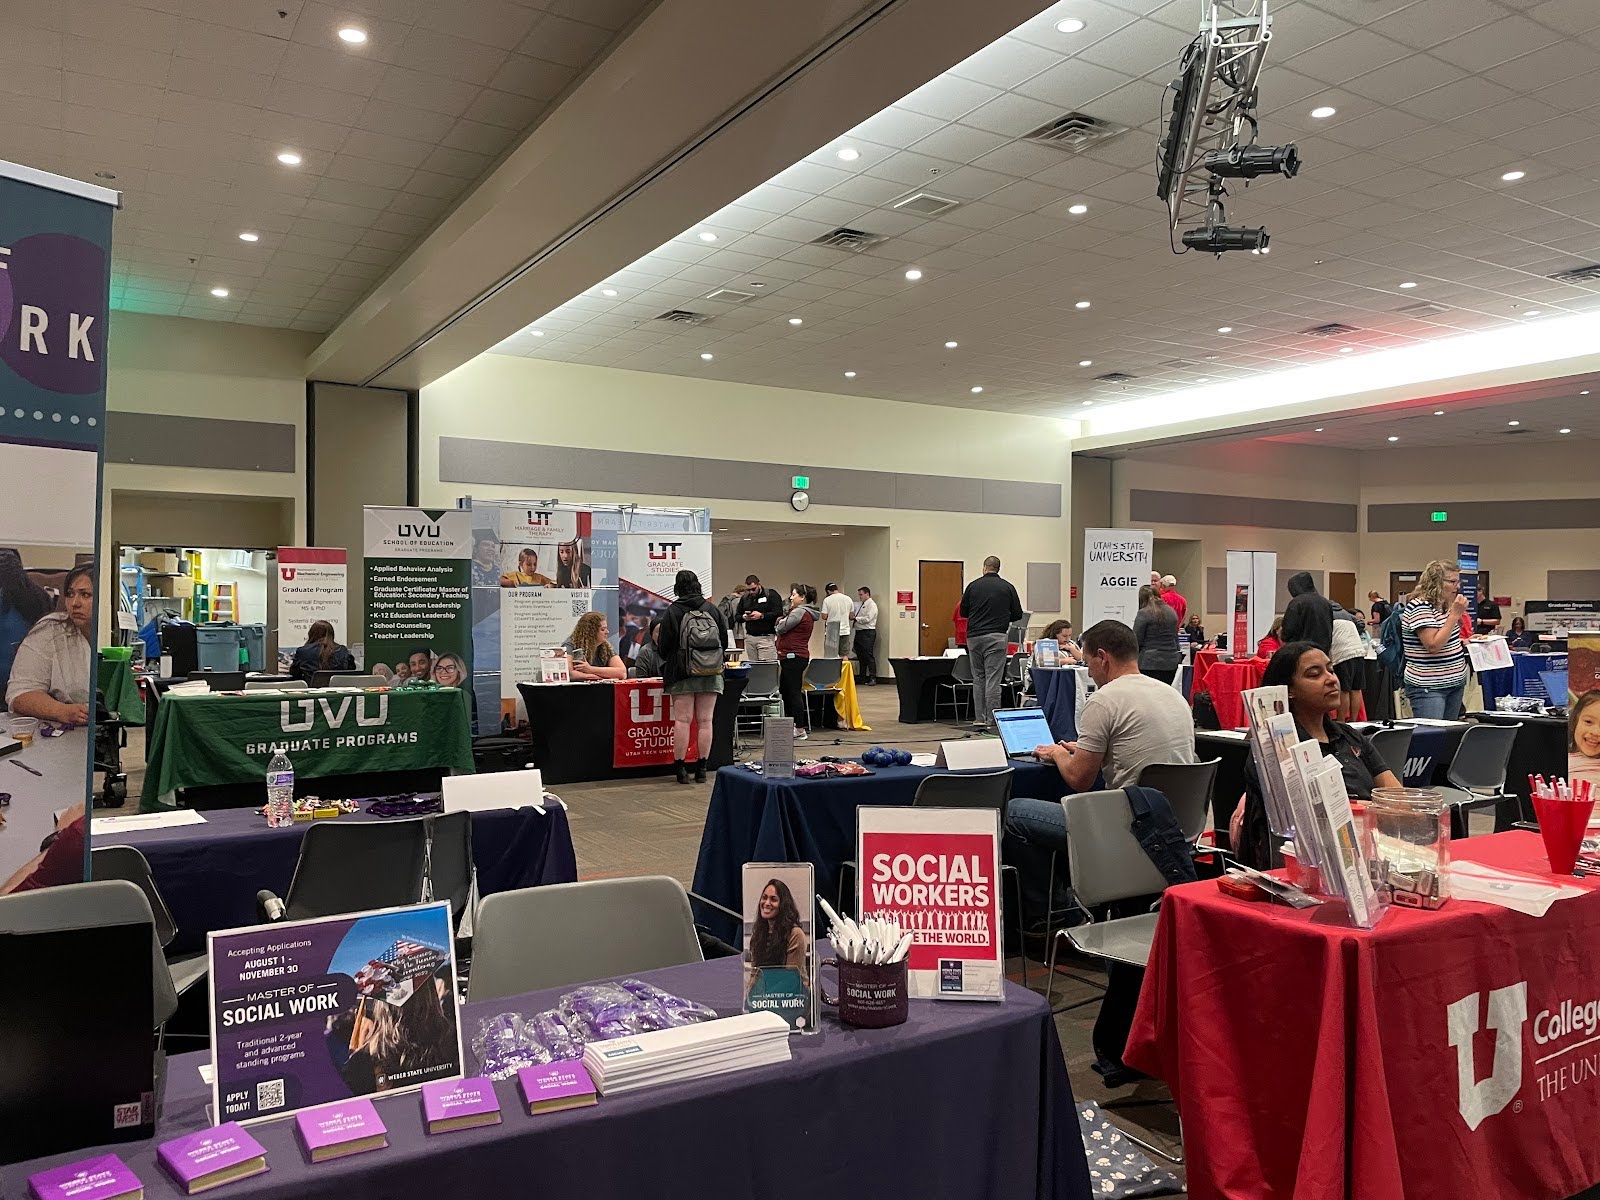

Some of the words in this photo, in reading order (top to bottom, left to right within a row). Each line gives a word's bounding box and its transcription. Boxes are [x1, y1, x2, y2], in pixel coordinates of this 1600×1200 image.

[398, 524, 440, 537] UVU
[1120, 542, 1145, 550] STATE
[1089, 551, 1148, 564] UNIVERSITY
[1100, 576, 1138, 587] AGGIE
[280, 694, 388, 732] UVU
[627, 726, 675, 738] GRADUA
[246, 738, 330, 755] GRADUATE
[336, 732, 418, 748] PROGRAMS
[634, 737, 674, 749] STUDIE
[872, 853, 989, 884] SOCIAL
[872, 883, 989, 907] WORKERS
[922, 933, 942, 943] THE
[945, 933, 989, 944] WORLD.
[228, 946, 265, 957] Accepting
[267, 940, 312, 952] Applications
[245, 956, 278, 969] AUGUST
[281, 956, 285, 964] 1
[240, 966, 285, 981] NOVEMBER
[287, 965, 299, 973] 30
[247, 986, 295, 1002] MASTER
[298, 983, 314, 993] OF
[847, 987, 872, 999] SOCIAL
[874, 988, 896, 999] WORK
[223, 1002, 284, 1026] SOCIAL
[289, 992, 339, 1015] WORK
[752, 1000, 779, 1009] SOCIAL
[781, 999, 804, 1008] WORK
[237, 1036, 277, 1050] Traditional
[280, 1032, 303, 1042] 2-year
[244, 1048, 259, 1058] and
[261, 1042, 296, 1055] advanced
[1447, 981, 1528, 1132] U
[236, 1058, 269, 1069] standing
[271, 1050, 305, 1064] programs
[388, 1072, 406, 1080] WEBER
[407, 1068, 423, 1077] STATE
[424, 1063, 453, 1073] UNIVERSITY
[1536, 1066, 1568, 1102] THE
[226, 1091, 249, 1102] APPLY
[225, 1102, 250, 1114] TODAY!
